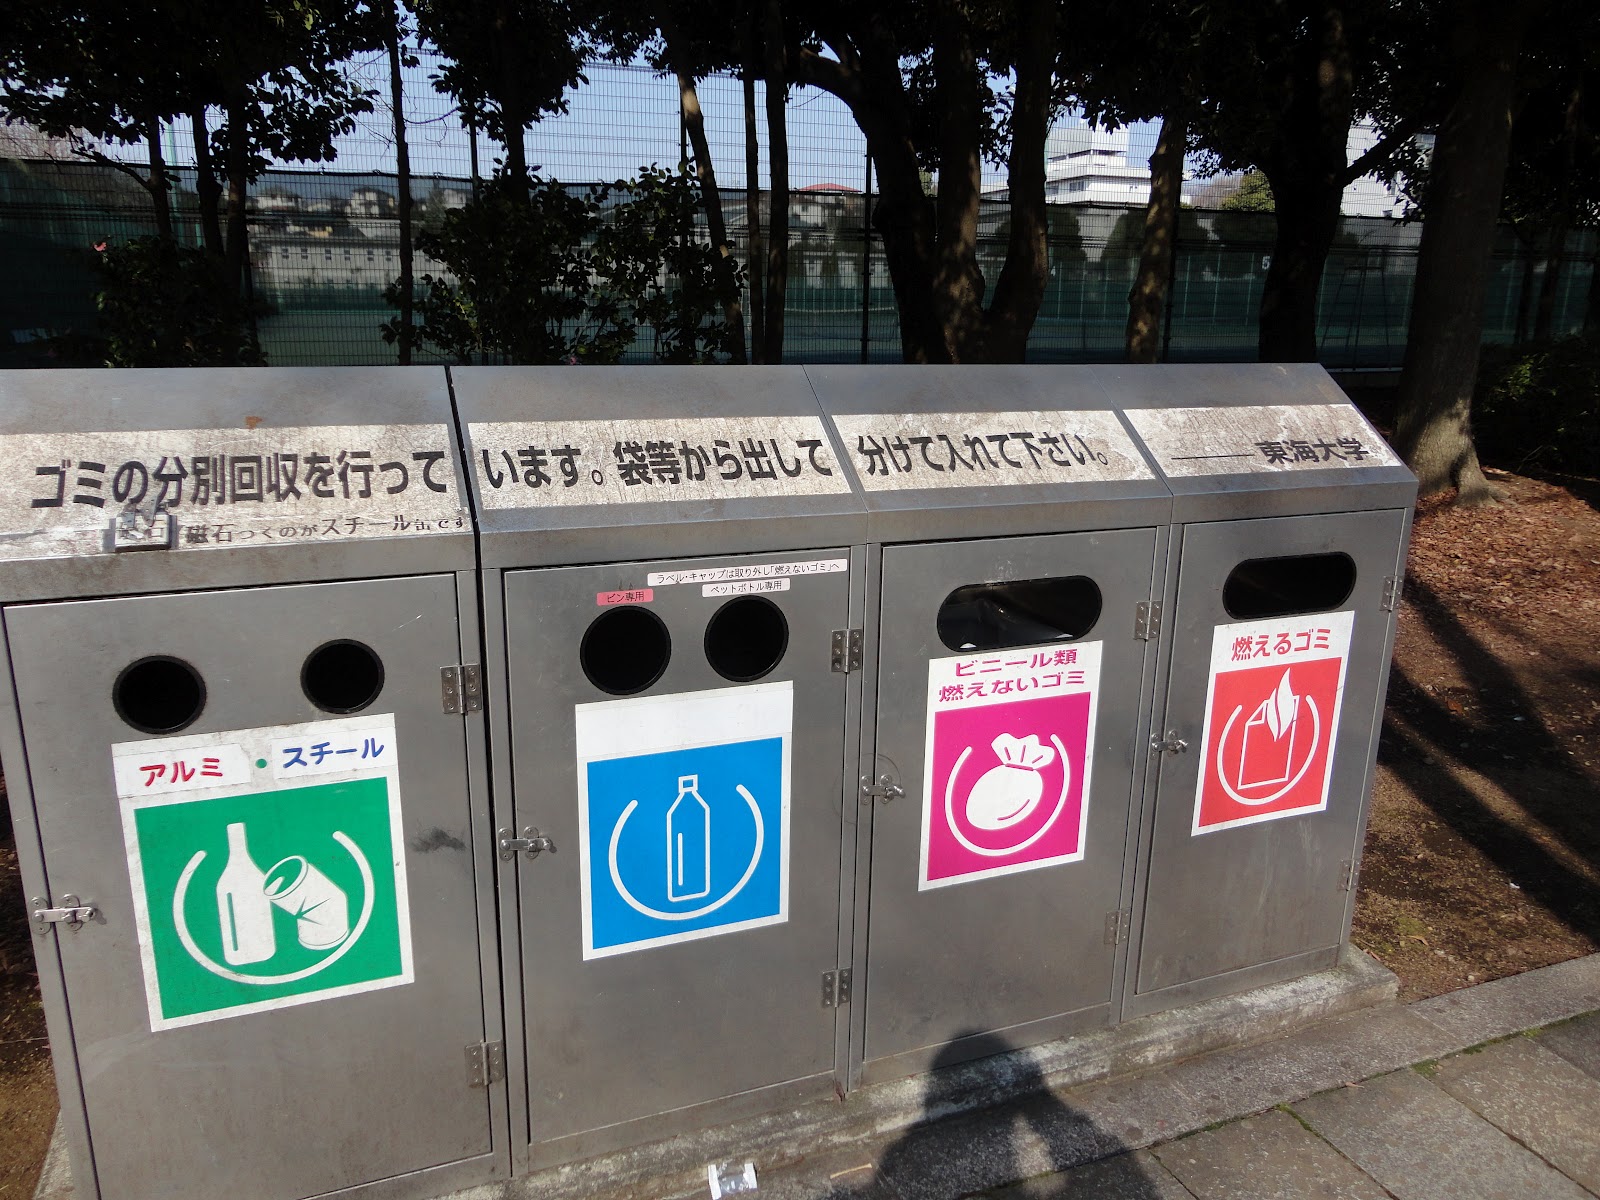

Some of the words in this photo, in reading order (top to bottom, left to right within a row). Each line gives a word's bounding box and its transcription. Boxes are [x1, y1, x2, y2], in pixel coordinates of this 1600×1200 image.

[31, 450, 447, 508] ゴミの分別回収を行って
[482, 438, 833, 488] います。袋等から出して
[857, 431, 1108, 476] 分けて入れて下さい。
[1255, 437, 1369, 465] 東海大学
[710, 580, 782, 594] ペットボトル専用
[1231, 628, 1331, 662] 燃えるゴミ
[955, 648, 1078, 677] ビニール類
[938, 670, 1086, 702] 燃えないゴミ
[139, 757, 224, 787] アルミ
[282, 737, 385, 769] スチール
